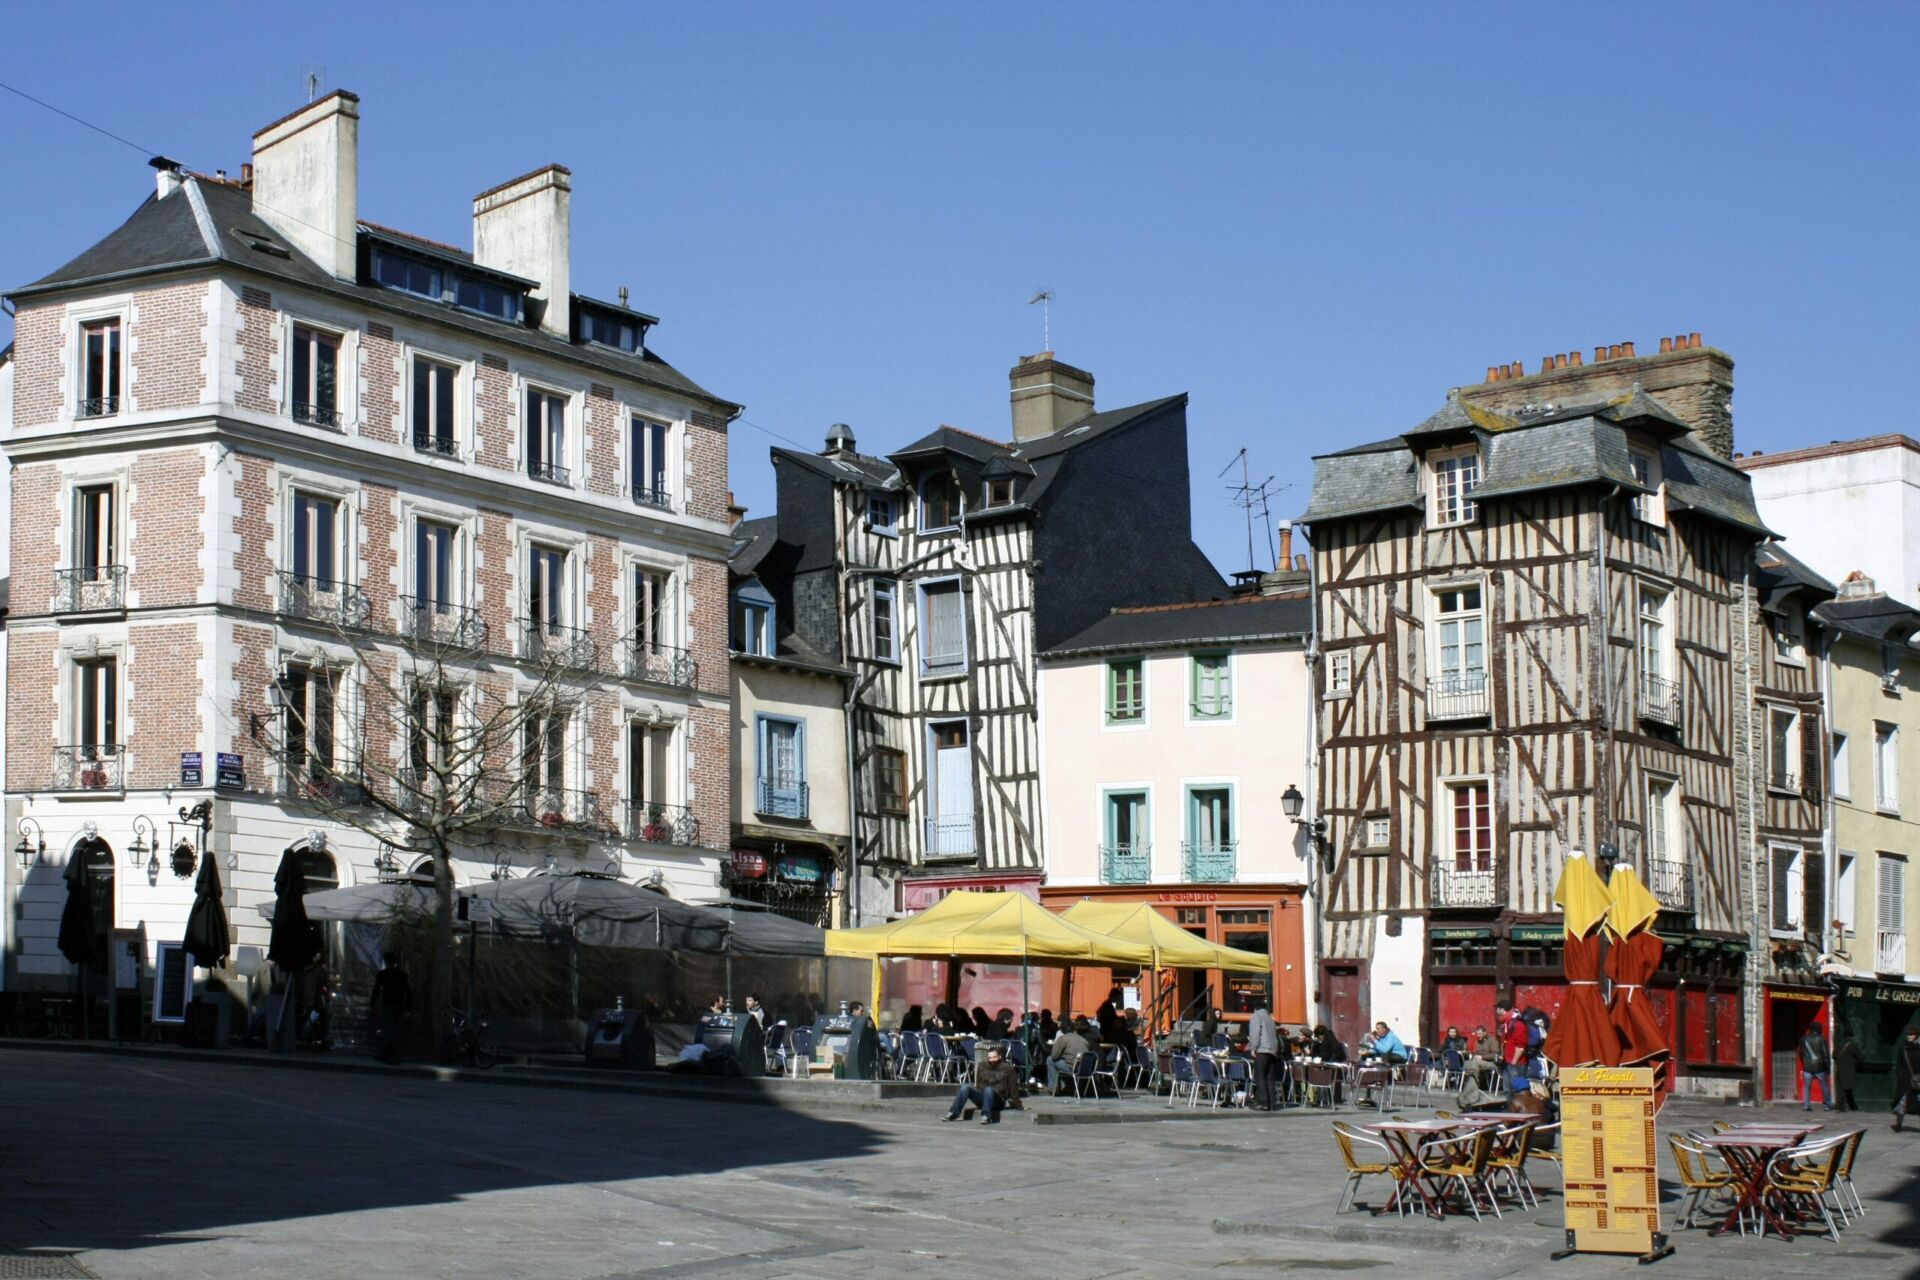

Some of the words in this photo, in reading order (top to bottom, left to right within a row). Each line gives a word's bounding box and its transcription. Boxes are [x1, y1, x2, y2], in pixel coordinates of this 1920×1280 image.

[1847, 986, 1863, 998] PUB
[1875, 989, 1889, 1000] LE
[1577, 1071, 1589, 1081] La
[1594, 1069, 1633, 1083] Fringale
[1598, 1087, 1620, 1095] chauds
